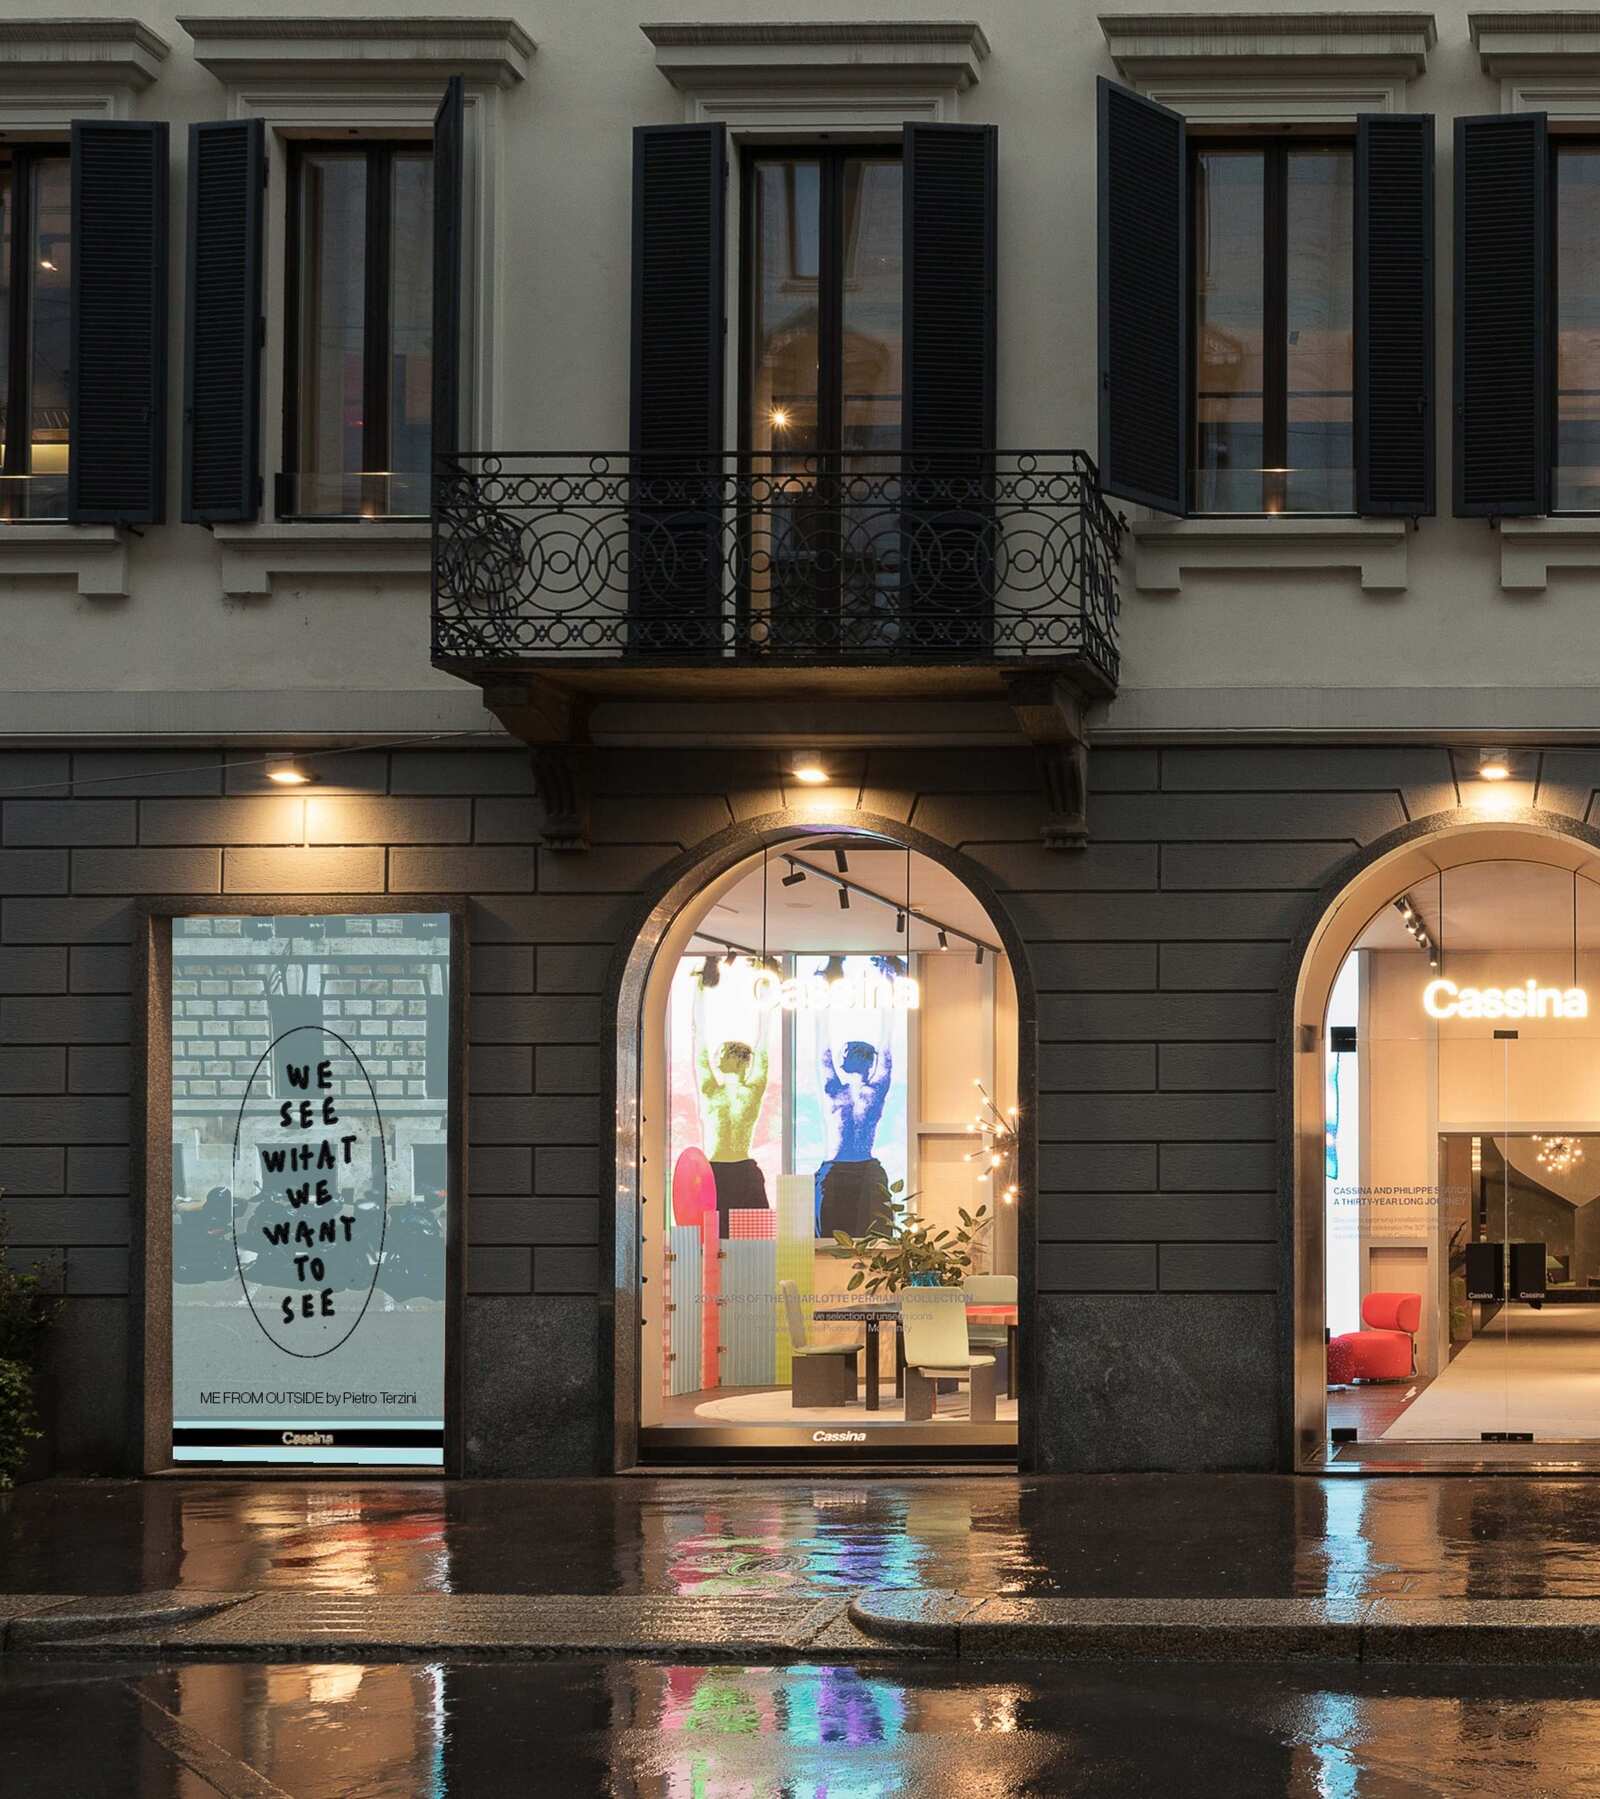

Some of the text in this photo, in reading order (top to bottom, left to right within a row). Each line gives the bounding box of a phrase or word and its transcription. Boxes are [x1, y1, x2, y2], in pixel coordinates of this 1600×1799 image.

[753, 968, 920, 1009] Cassina
[1423, 978, 1588, 1018] Cassina
[286, 1060, 333, 1089] WE
[280, 1096, 338, 1129] SEE
[262, 1135, 357, 1173] WHAT
[286, 1179, 332, 1209] WE
[1333, 1187, 1372, 1195] CASSINA
[1373, 1187, 1393, 1195] AND
[1393, 1187, 1433, 1195] PHILIPPE
[1334, 1198, 1340, 1206] A
[1341, 1198, 1398, 1206] THIRTY-YEAR
[1399, 1198, 1424, 1206] LONG
[262, 1215, 356, 1248] WANT
[293, 1255, 325, 1282] TO
[281, 1287, 336, 1324] SEE
[747, 1294, 760, 1304] OF
[764, 1294, 785, 1304] THE
[906, 1294, 973, 1304] COLLECTION
[826, 1312, 865, 1321] selection
[866, 1312, 876, 1321] of
[200, 1392, 417, 1407] ME FROM OUTSIDE by Pietro Terzini
[281, 1431, 334, 1445] Cassina
[812, 1430, 867, 1442] Cassina
